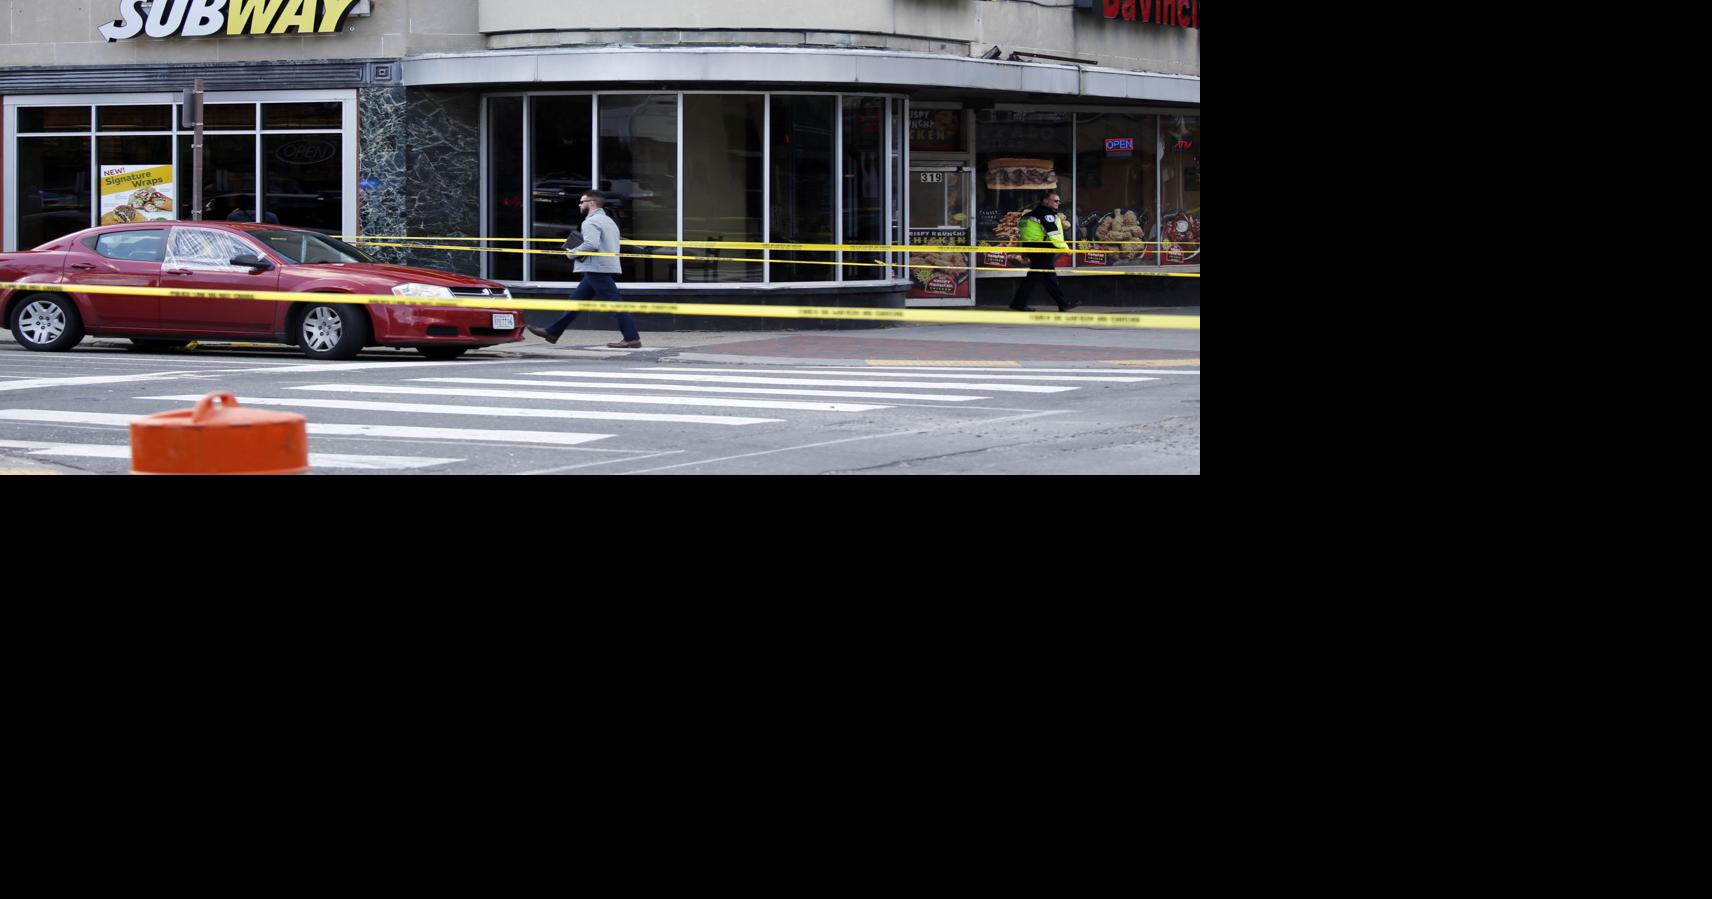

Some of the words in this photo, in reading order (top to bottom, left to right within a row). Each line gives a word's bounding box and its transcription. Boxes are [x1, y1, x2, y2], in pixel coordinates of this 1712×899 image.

[98, 0, 356, 42] SUBWAY
[1106, 140, 1133, 149] OPEN
[283, 143, 328, 159] OPEN
[104, 167, 125, 176] NEW!
[105, 171, 152, 185] Signature
[131, 177, 164, 188] Wraps
[921, 173, 942, 182] 319
